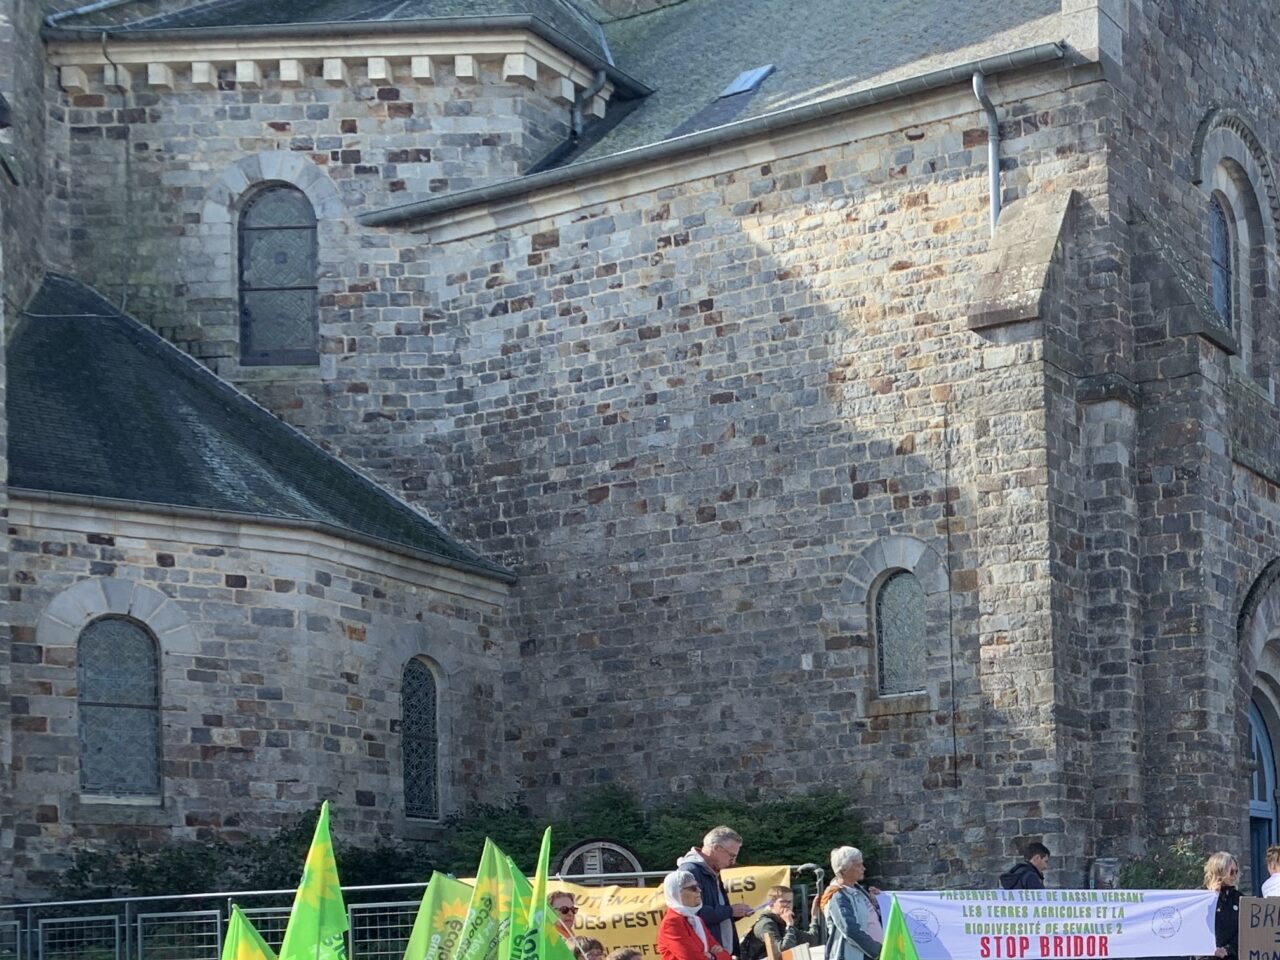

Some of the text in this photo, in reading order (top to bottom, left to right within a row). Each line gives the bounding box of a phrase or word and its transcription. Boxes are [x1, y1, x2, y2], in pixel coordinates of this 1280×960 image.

[1001, 890, 1015, 900] LA
[1046, 891, 1057, 901] DE
[1061, 891, 1097, 902] BASSIN
[1102, 892, 1144, 903] VERSANT
[962, 905, 1125, 918] LES TERRES AGRICOLES ET LA
[574, 914, 607, 930] DES
[965, 920, 1123, 935] BIODIVERSITÉ DE SEVAILLE 2
[980, 936, 1109, 958] STOP BRIDOR
